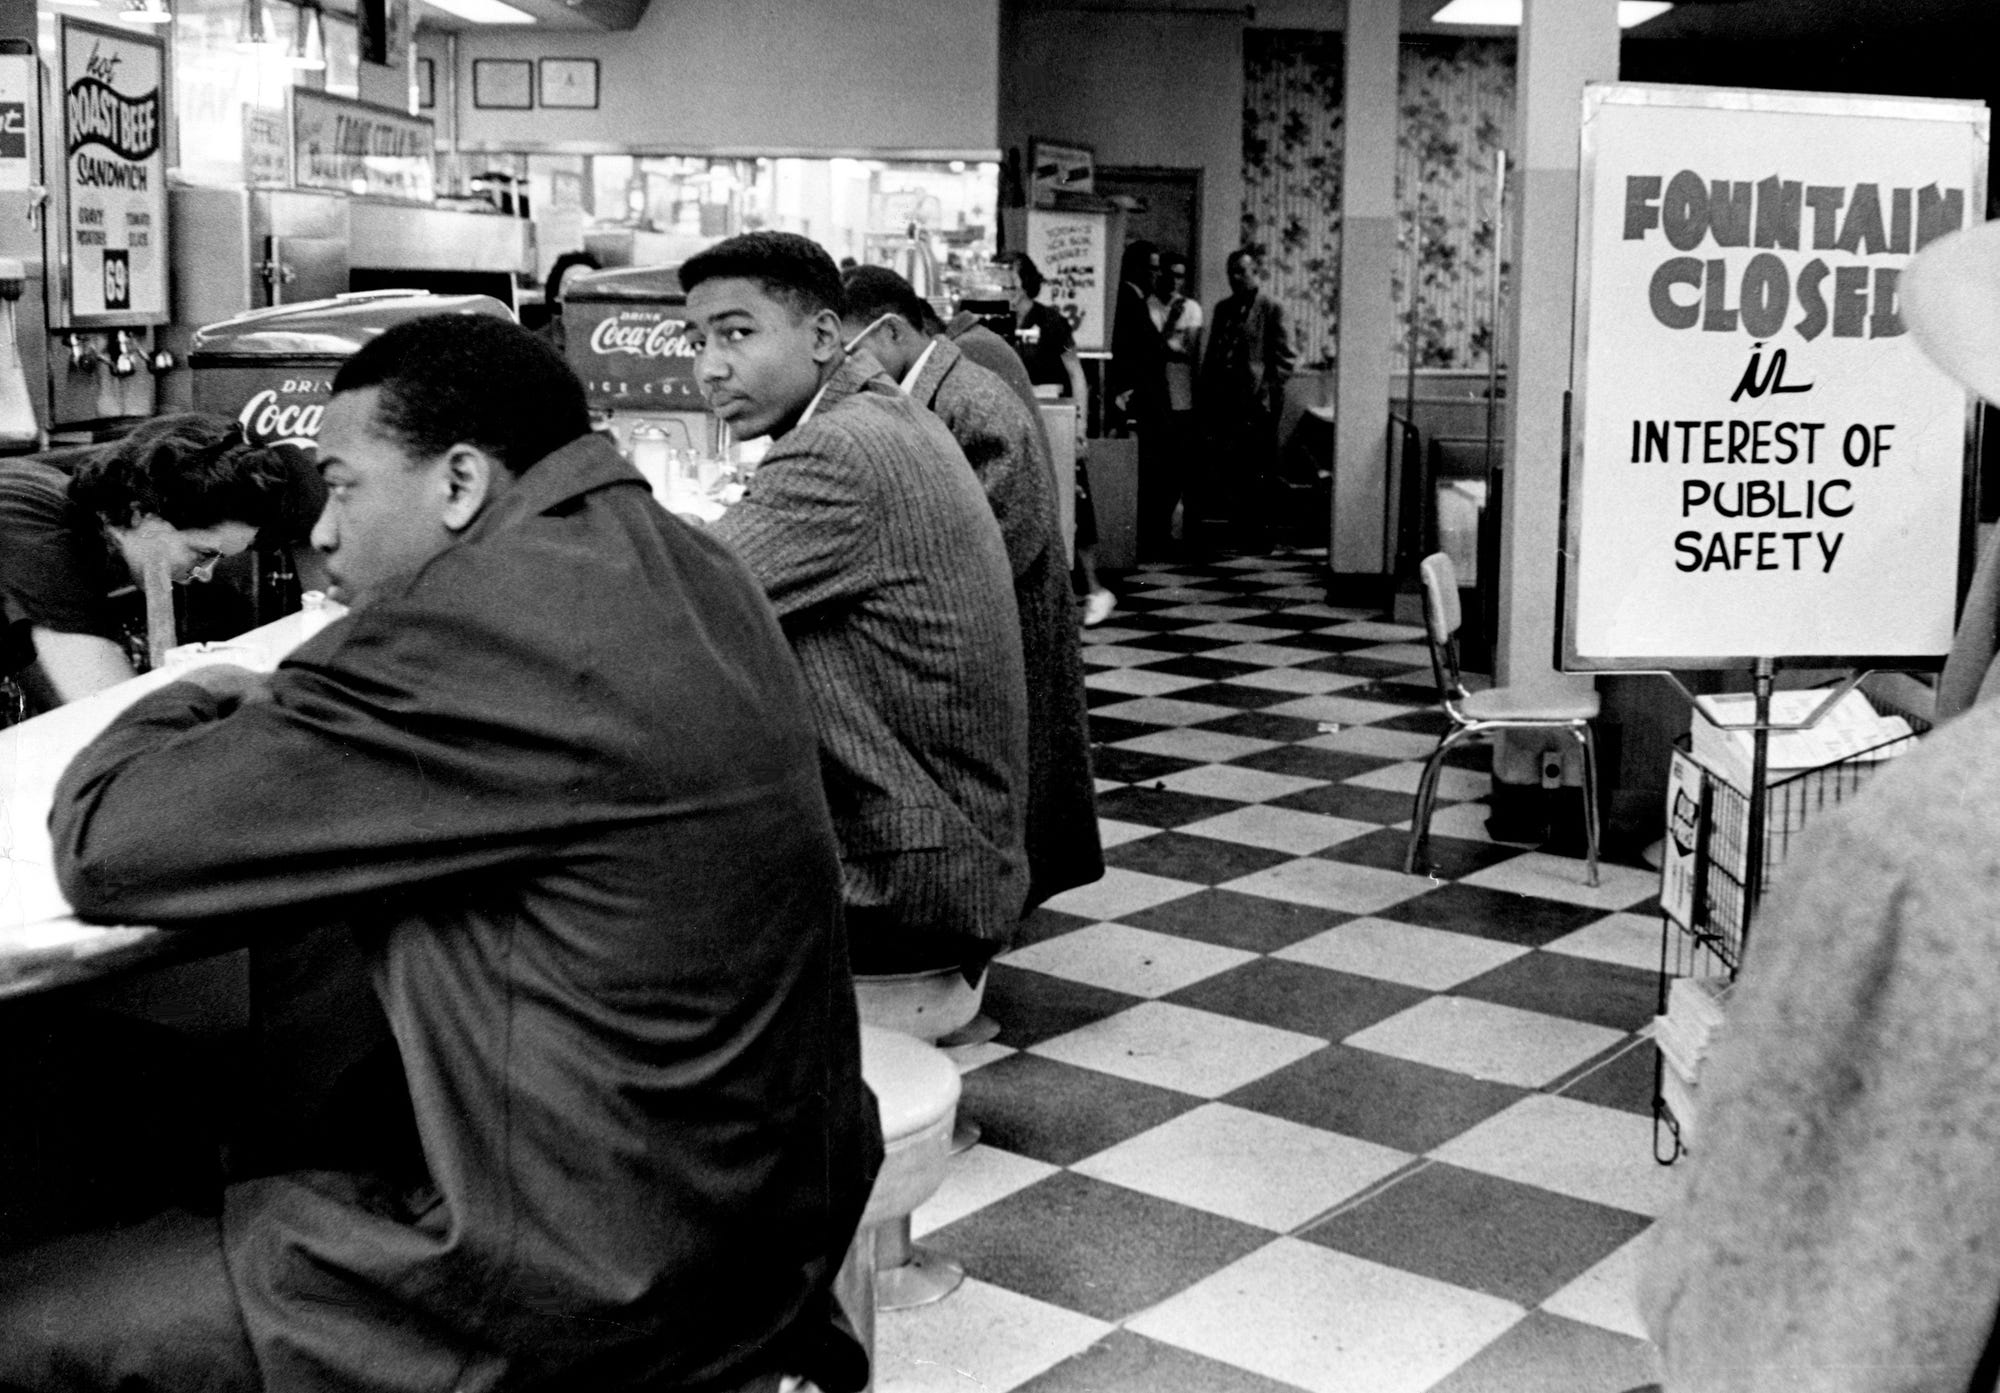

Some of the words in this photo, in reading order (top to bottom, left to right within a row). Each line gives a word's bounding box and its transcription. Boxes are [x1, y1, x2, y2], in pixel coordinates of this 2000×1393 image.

[68, 84, 119, 145] ROAST
[120, 100, 155, 153] BEEF
[76, 153, 148, 192] SANDWICH
[1623, 169, 1964, 256] FOUNTAIN
[620, 311, 663, 321] DRINK
[1648, 252, 1909, 343] CLOSED
[280, 379, 333, 393] DRIN
[588, 381, 628, 394] ICE
[643, 382, 692, 395] COL
[1730, 342, 1814, 403] in
[238, 389, 325, 448] Coca
[1631, 420, 1826, 465] INTEREST
[1842, 423, 1896, 468] OF
[1682, 479, 1855, 519] PUBLIC
[1674, 530, 1844, 574] SAFETY
